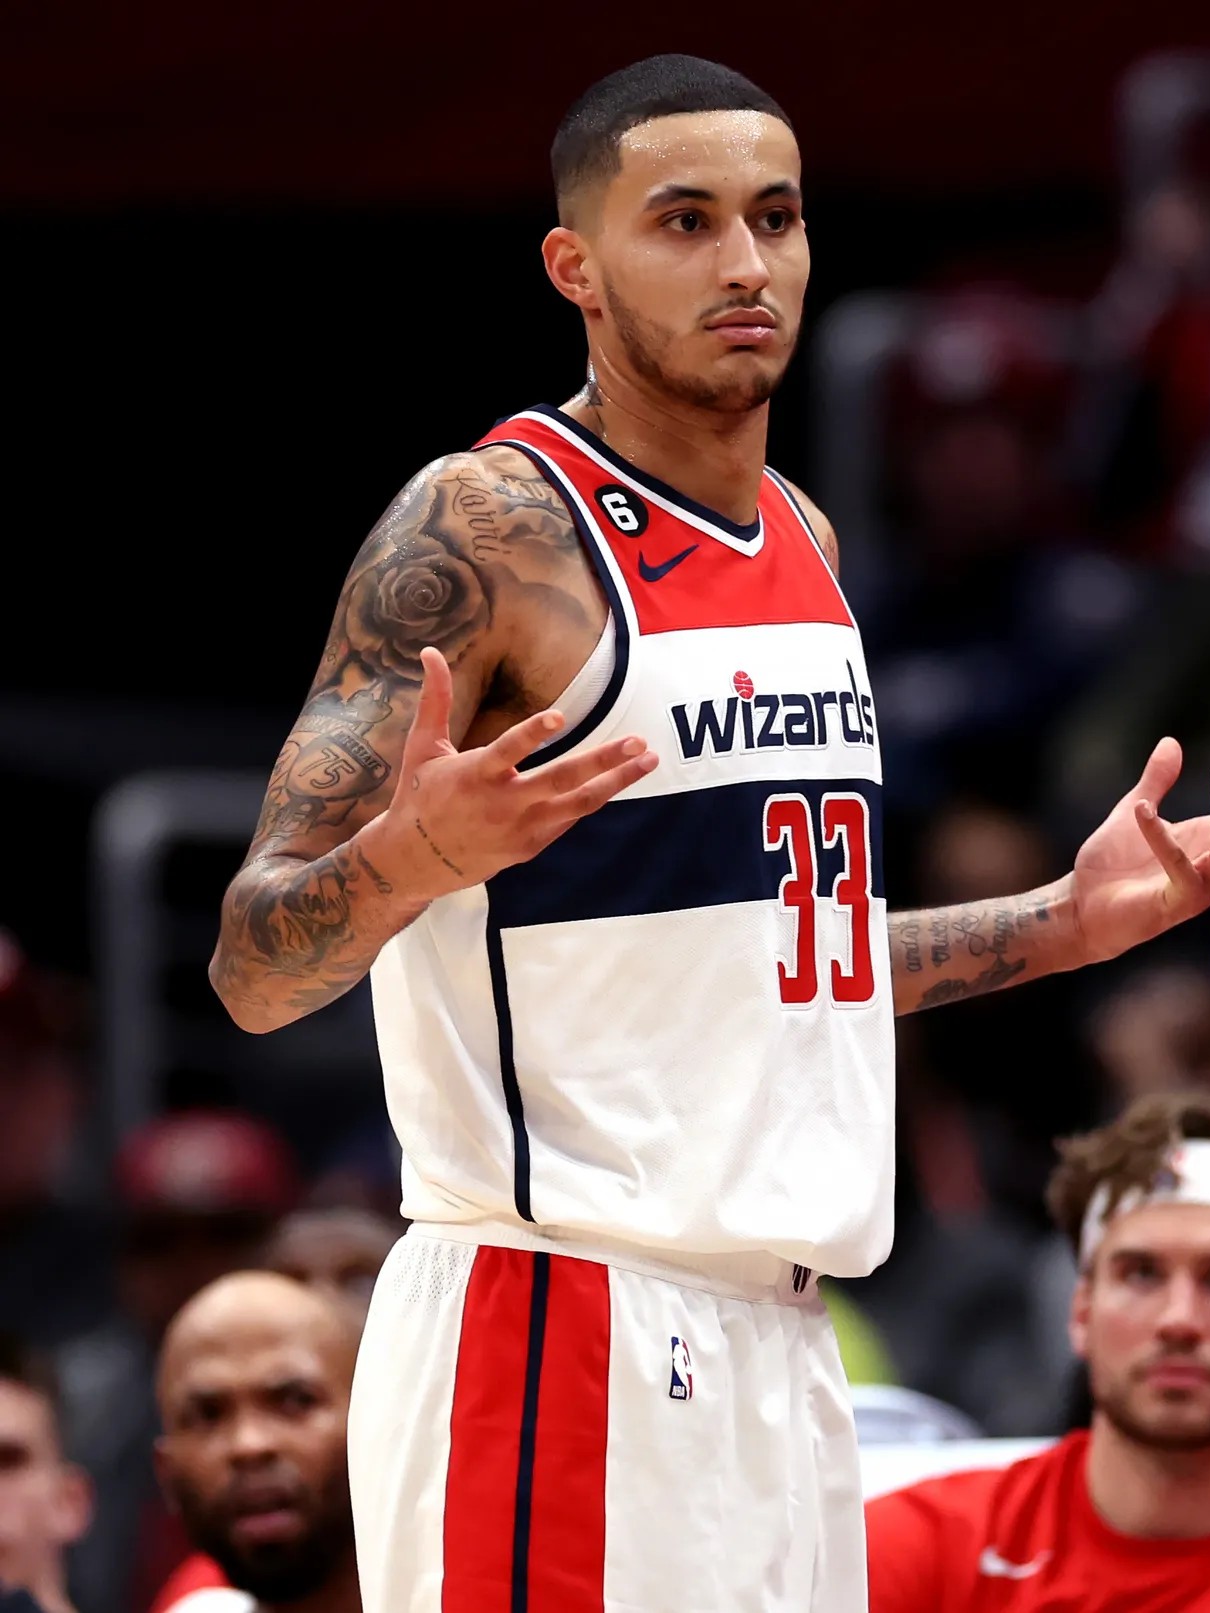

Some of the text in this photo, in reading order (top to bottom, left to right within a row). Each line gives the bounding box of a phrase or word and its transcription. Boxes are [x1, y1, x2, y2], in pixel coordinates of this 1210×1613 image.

[601, 491, 640, 531] 6
[298, 747, 356, 789] 75
[765, 794, 877, 1008] 33
